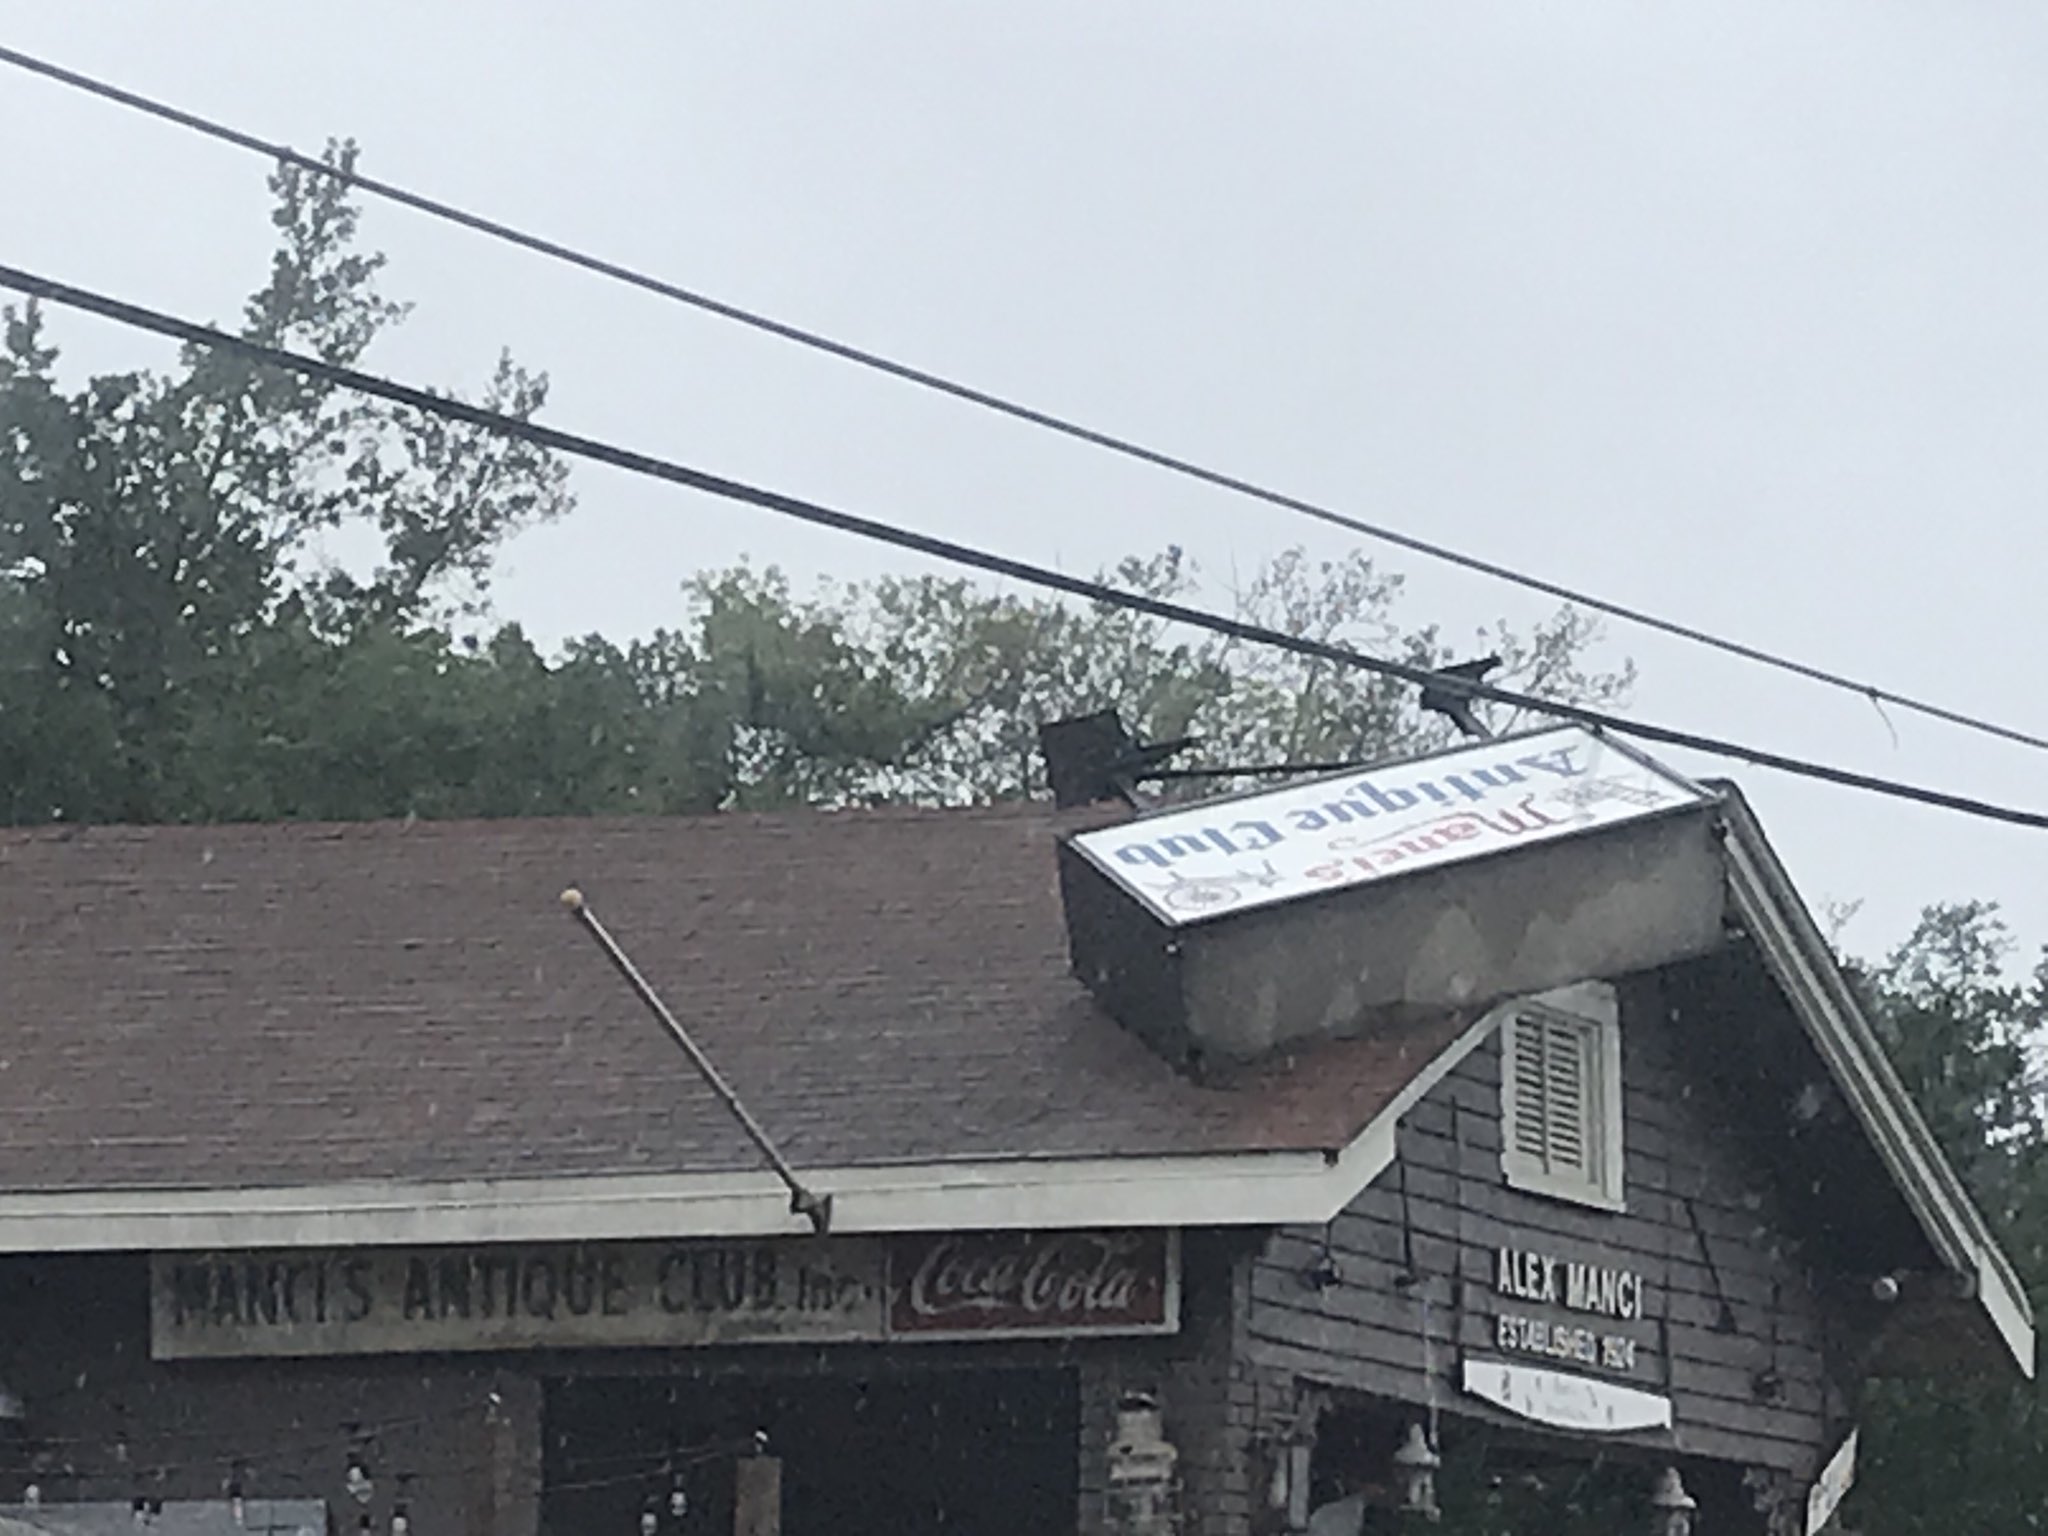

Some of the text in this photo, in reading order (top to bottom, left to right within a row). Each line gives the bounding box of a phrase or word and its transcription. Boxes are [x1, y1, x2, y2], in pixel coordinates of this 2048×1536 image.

[1115, 746, 1591, 866] Antique Club
[404, 1252, 630, 1321] ANTIQUE
[1498, 1247, 1642, 1319] ALEX MANCI
